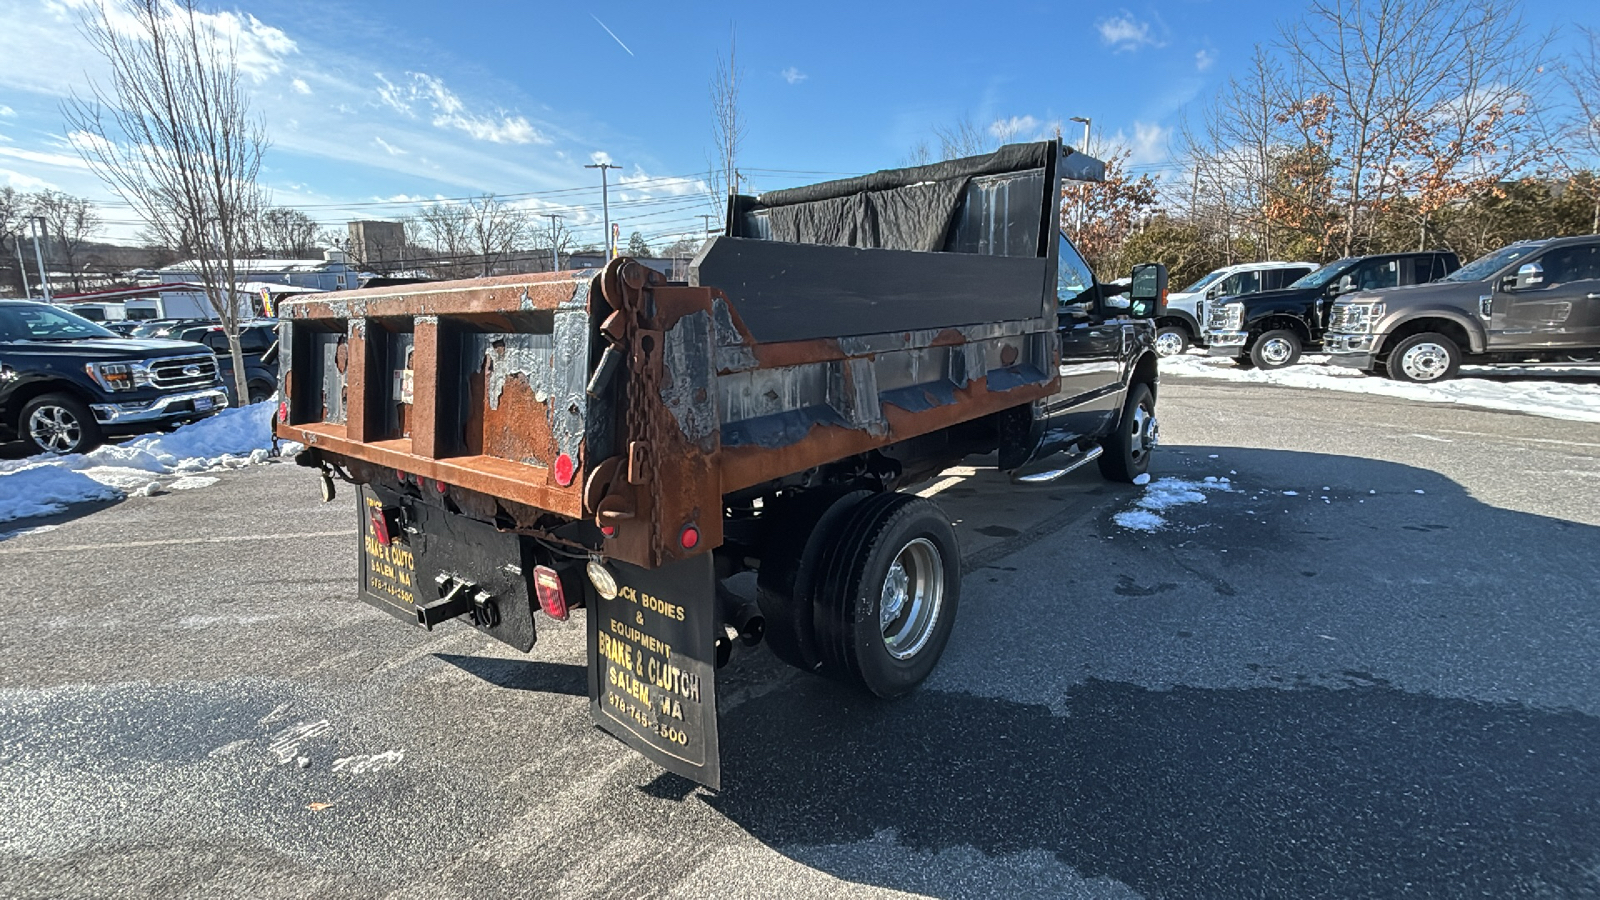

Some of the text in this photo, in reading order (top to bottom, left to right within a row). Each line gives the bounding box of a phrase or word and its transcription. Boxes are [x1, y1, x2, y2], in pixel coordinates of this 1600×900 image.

[399, 571, 411, 587] MA
[635, 611, 644, 626] &
[642, 593, 685, 622] BODIES
[610, 618, 672, 659] EQUIPMENT
[598, 630, 701, 703] BRAKE & CLUTCH
[609, 666, 652, 710] SALEM,
